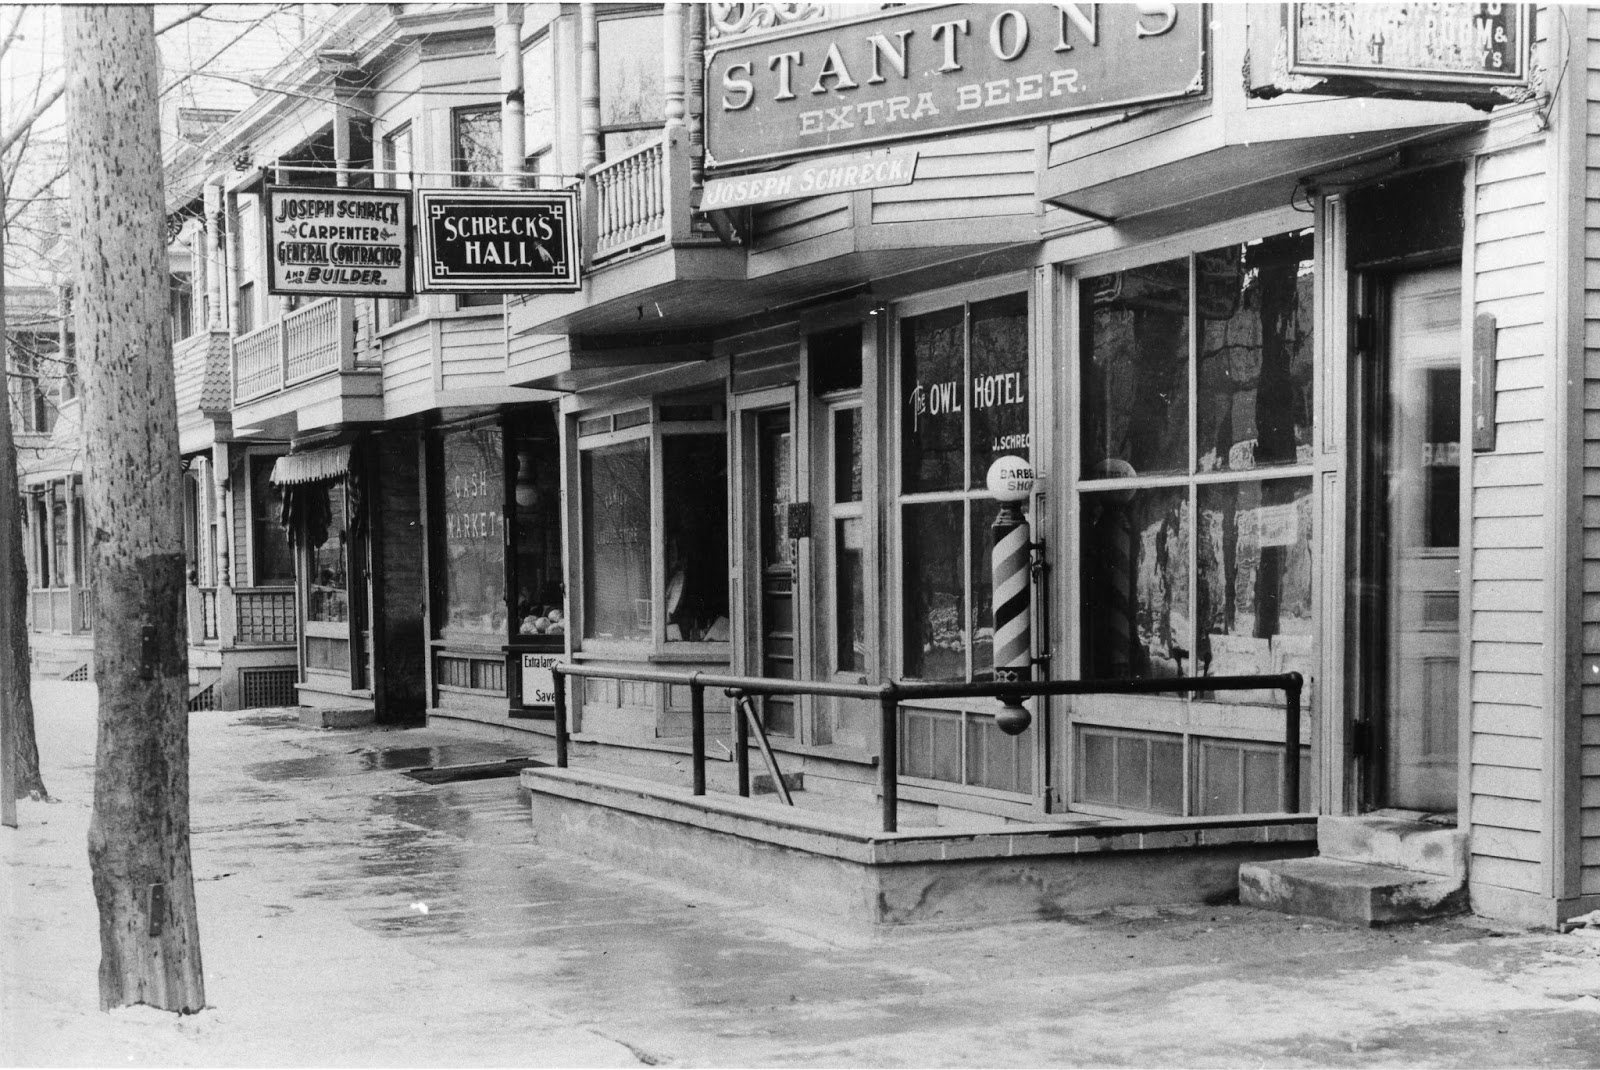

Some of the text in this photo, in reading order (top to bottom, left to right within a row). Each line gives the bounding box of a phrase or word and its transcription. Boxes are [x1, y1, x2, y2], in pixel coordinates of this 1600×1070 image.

[799, 68, 1087, 135] EXTRA BEER.
[707, 175, 792, 205] JOSEPH
[275, 199, 399, 226] JOSEPH SCHRECK
[299, 222, 380, 242] CARPENTER
[277, 241, 402, 267] GENERAL CONTRACTOR
[465, 241, 533, 267] HALL
[930, 381, 961, 415] OWL
[974, 372, 1025, 410] HOTEL
[454, 471, 487, 498] CASH
[446, 512, 496, 538] MARKET
